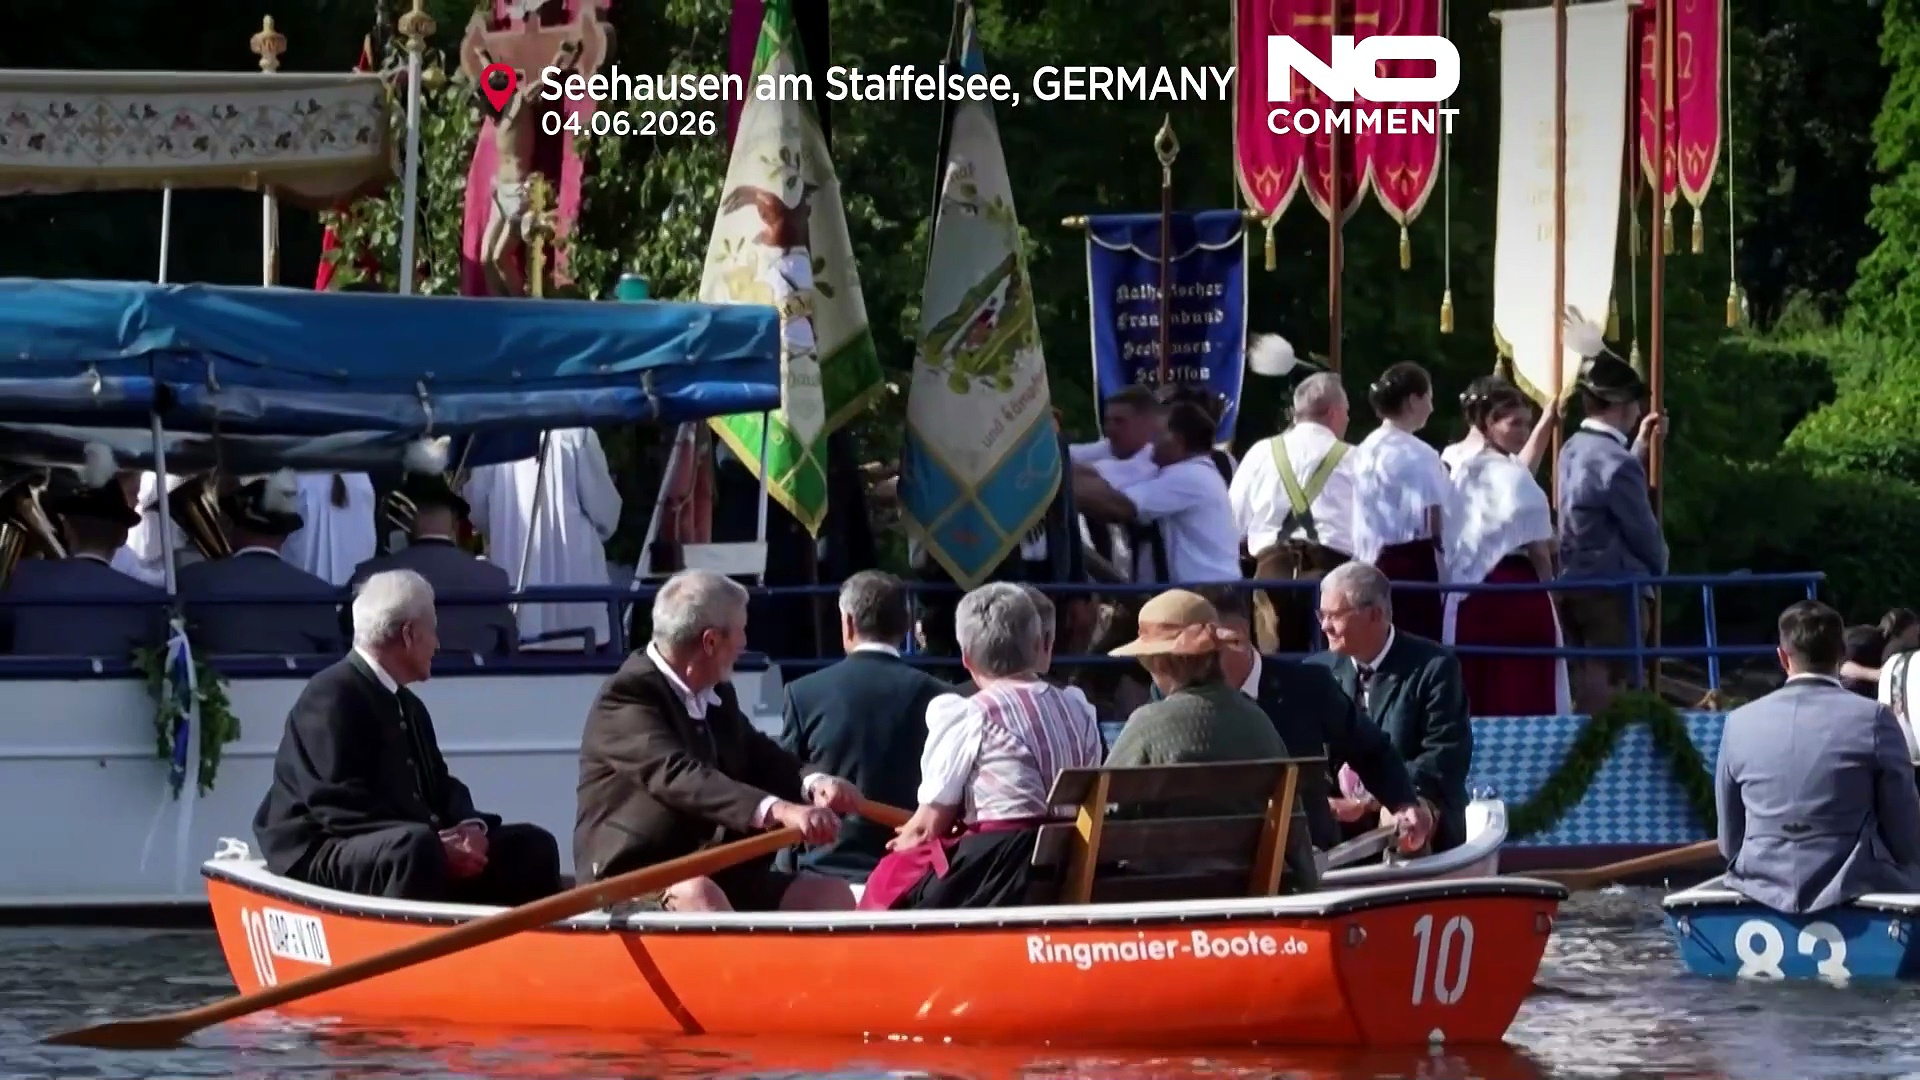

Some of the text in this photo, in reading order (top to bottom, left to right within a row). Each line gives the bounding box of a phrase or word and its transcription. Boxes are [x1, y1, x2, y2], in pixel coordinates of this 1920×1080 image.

[1116, 282, 1224, 304] Kathoischer
[1117, 308, 1224, 330] Fraunbund
[1123, 339, 1211, 360] Seehusen
[240, 906, 278, 988] 10
[1027, 929, 1308, 970] Ringmaier-Boote.de
[1412, 914, 1475, 1006] 10
[1735, 919, 1850, 981] 83
